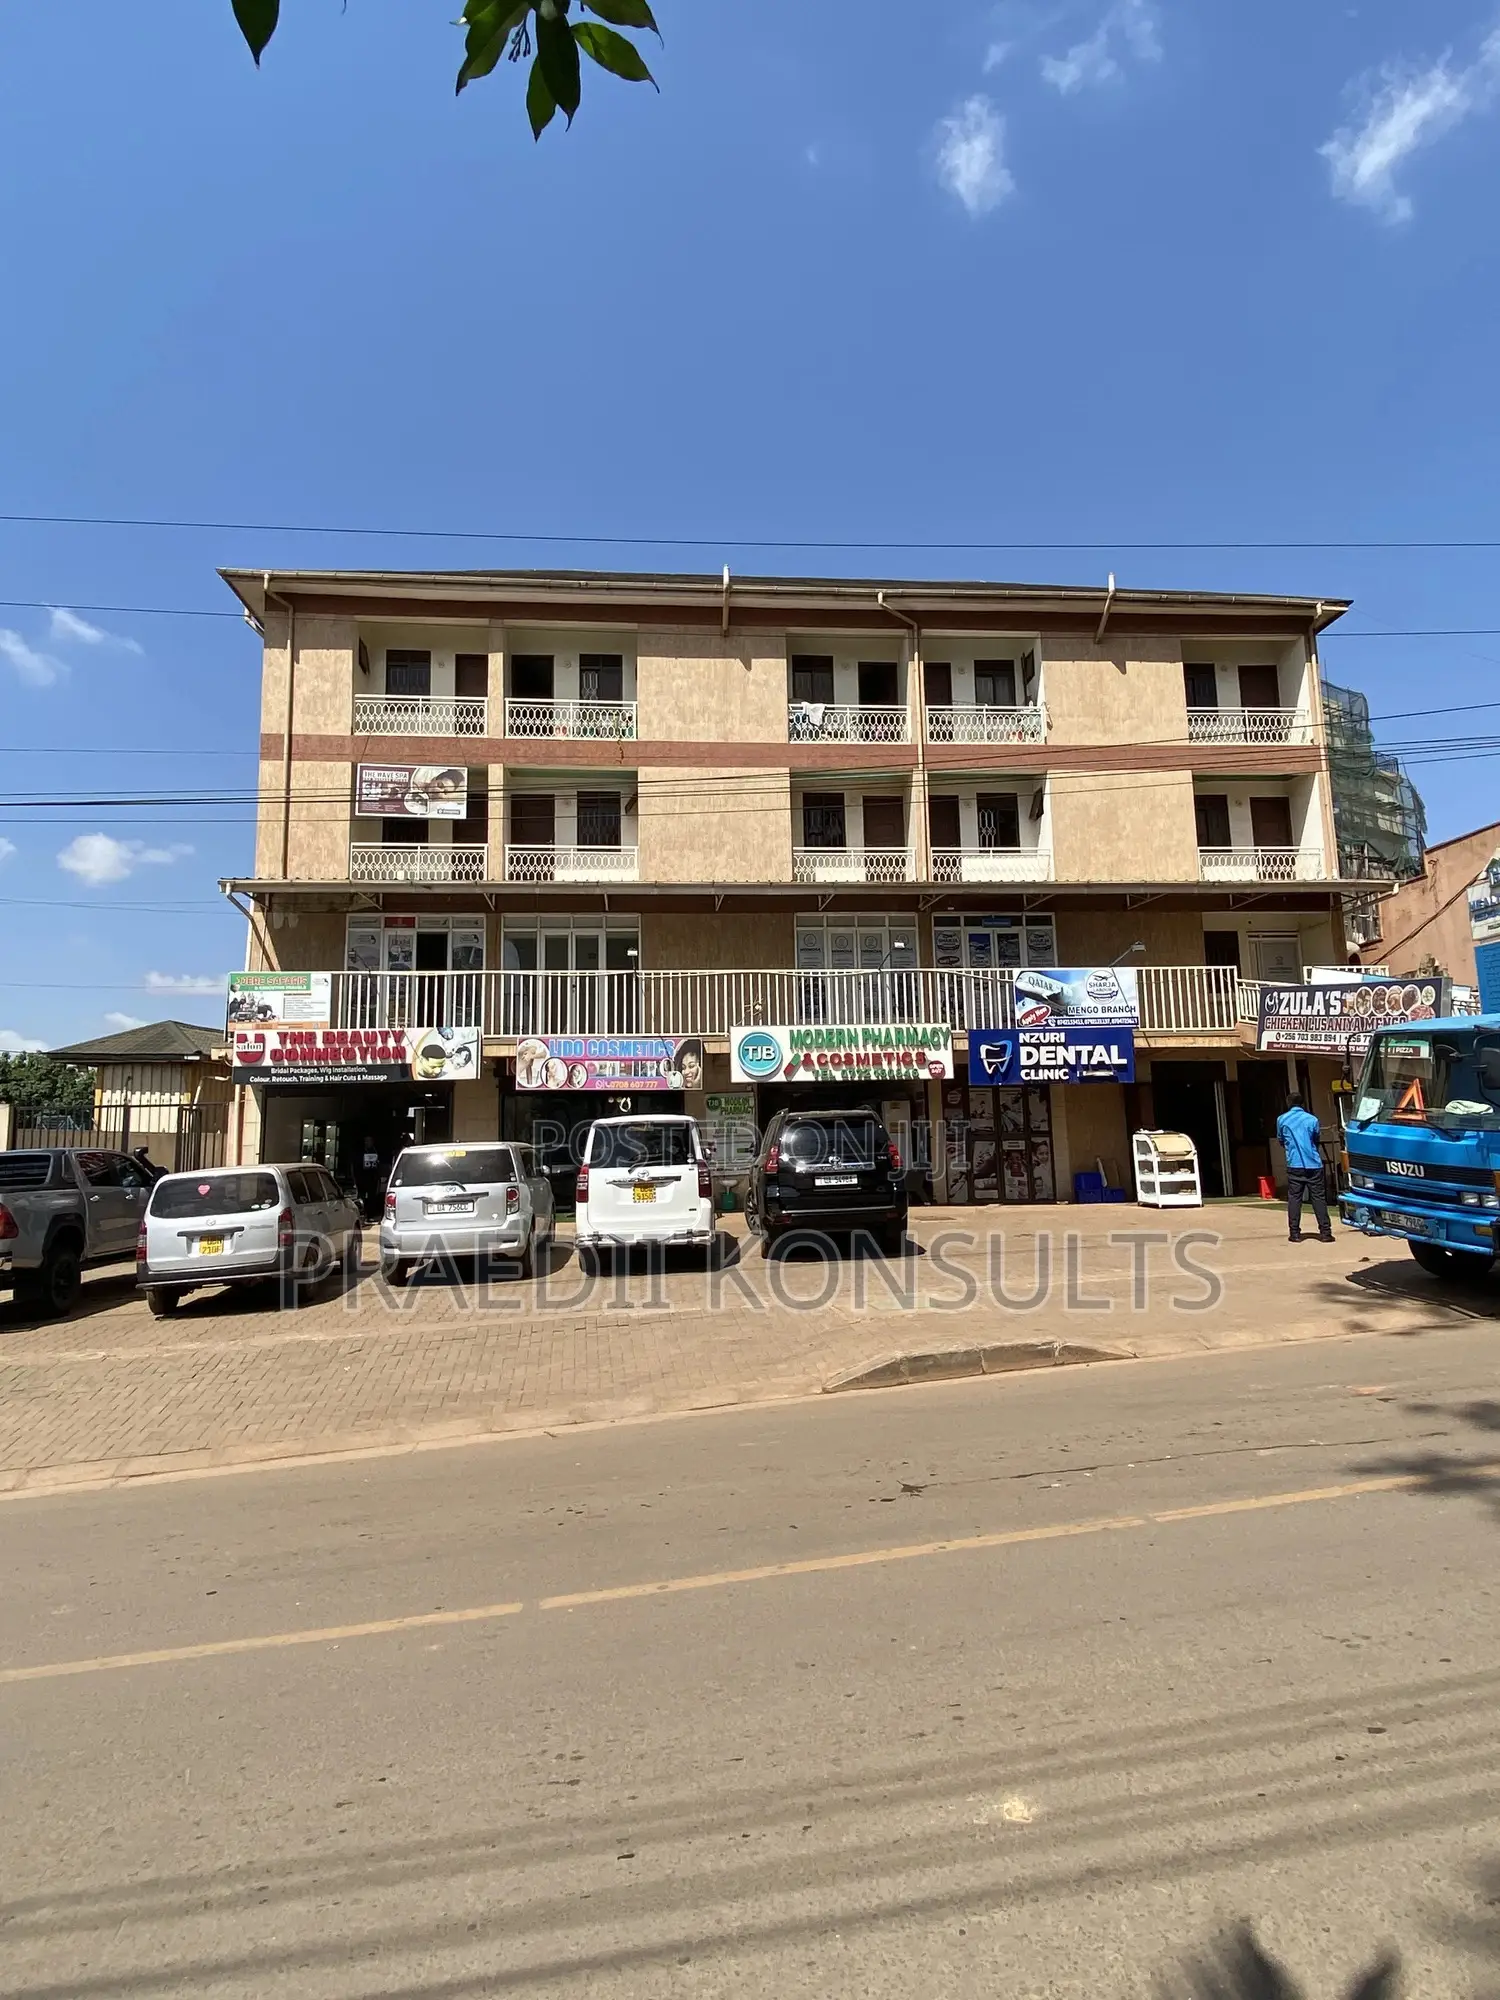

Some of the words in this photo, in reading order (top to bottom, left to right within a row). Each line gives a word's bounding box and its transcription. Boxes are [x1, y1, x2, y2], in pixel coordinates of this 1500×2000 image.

[1028, 976, 1054, 992] QATAR
[1088, 980, 1116, 988] SHARJA
[1068, 1006, 1099, 1014] MENGO
[1101, 1006, 1136, 1014] BRANCH
[1279, 991, 1341, 1016] ZULA'S
[1265, 1016, 1308, 1031] CHICKEN
[1308, 1016, 1362, 1031] LUSANIYA
[278, 1031, 316, 1046] THE
[322, 1030, 406, 1046] BEAUTY
[790, 1029, 860, 1049] MODERN
[862, 1027, 950, 1049] PHARMACY
[1019, 1032, 1065, 1043] NZURI
[236, 1042, 262, 1050] salon
[550, 1040, 585, 1058] LIDO
[587, 1040, 675, 1058] COSMETICS
[744, 1046, 776, 1060] TJB
[270, 1046, 407, 1062] CONNECTION
[802, 1052, 814, 1066] &
[817, 1052, 926, 1066] COSMETICS
[1020, 1045, 1127, 1065] DENTAL
[362, 1074, 387, 1082] Massage
[1021, 1068, 1069, 1080] CLINIC
[1386, 1160, 1424, 1177] ISUZU
